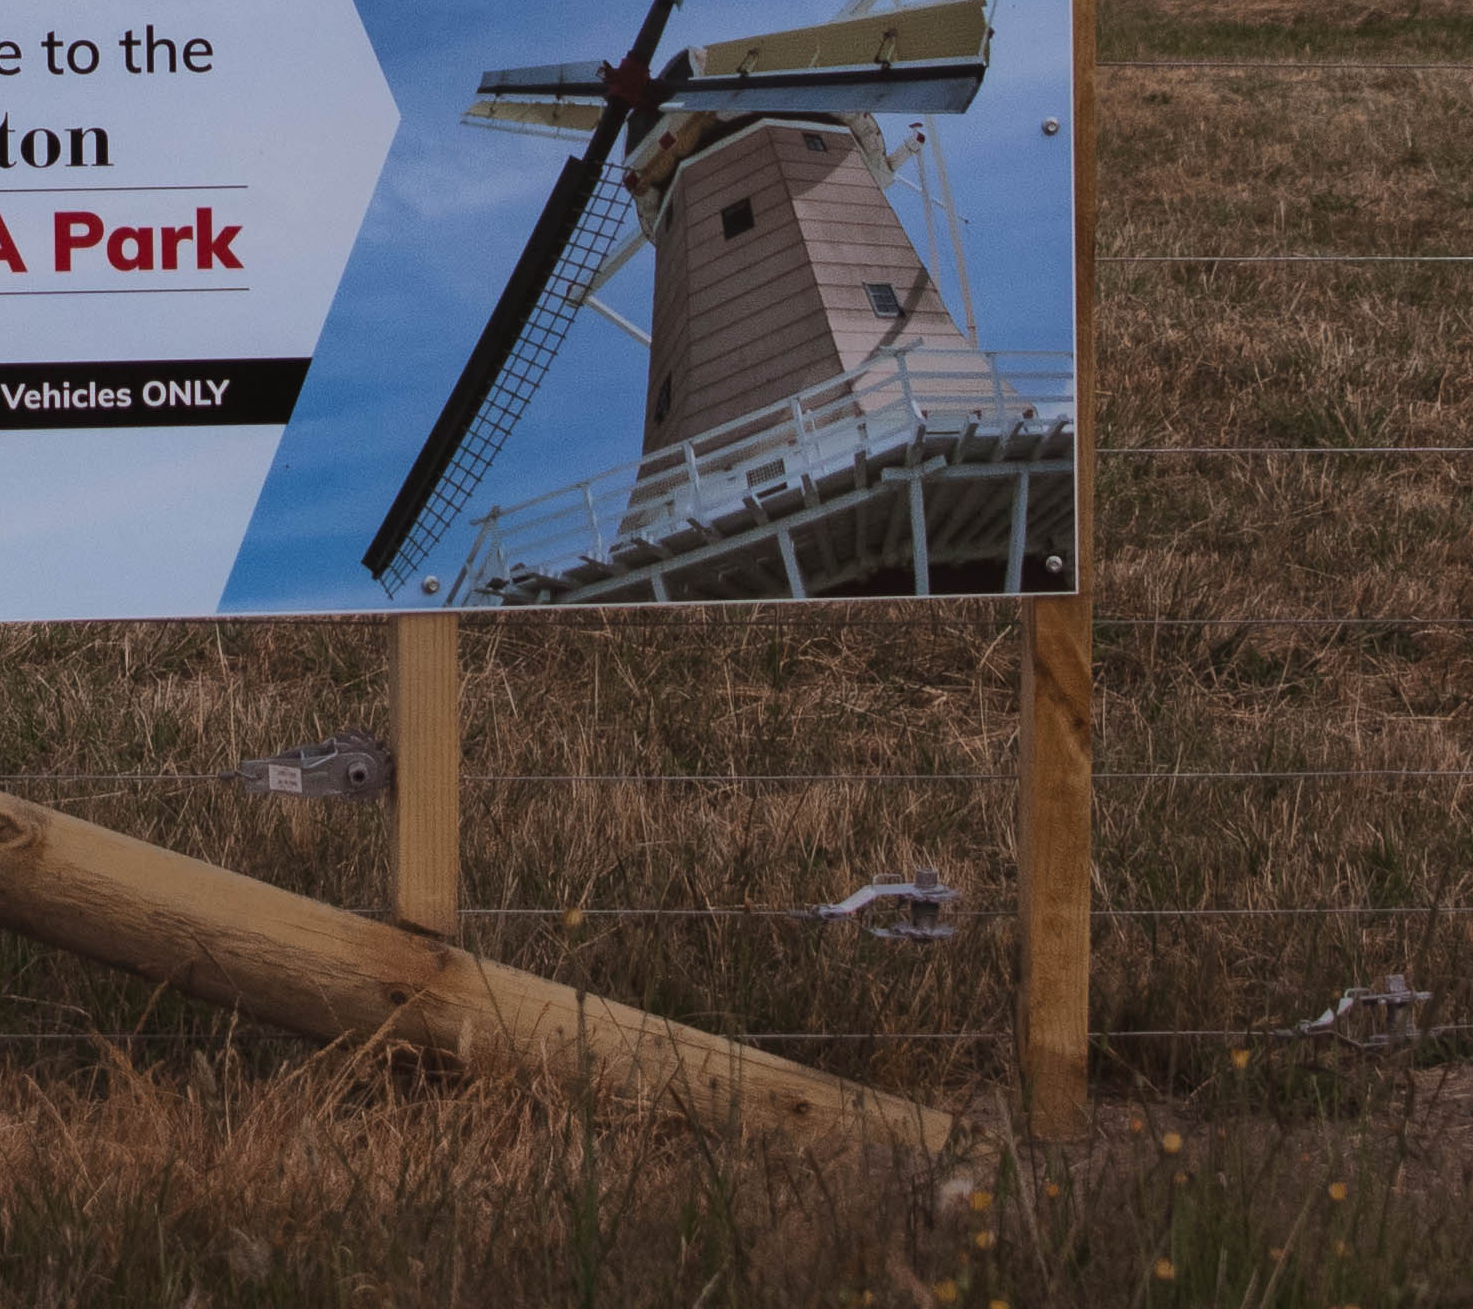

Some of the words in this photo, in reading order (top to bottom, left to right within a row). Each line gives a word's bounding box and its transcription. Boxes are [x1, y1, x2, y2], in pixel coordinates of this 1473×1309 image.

[41, 30, 100, 76] to
[118, 24, 214, 73] the
[53, 206, 246, 272] Park
[0, 381, 132, 411] Vehicles
[141, 379, 230, 407] ONLY
